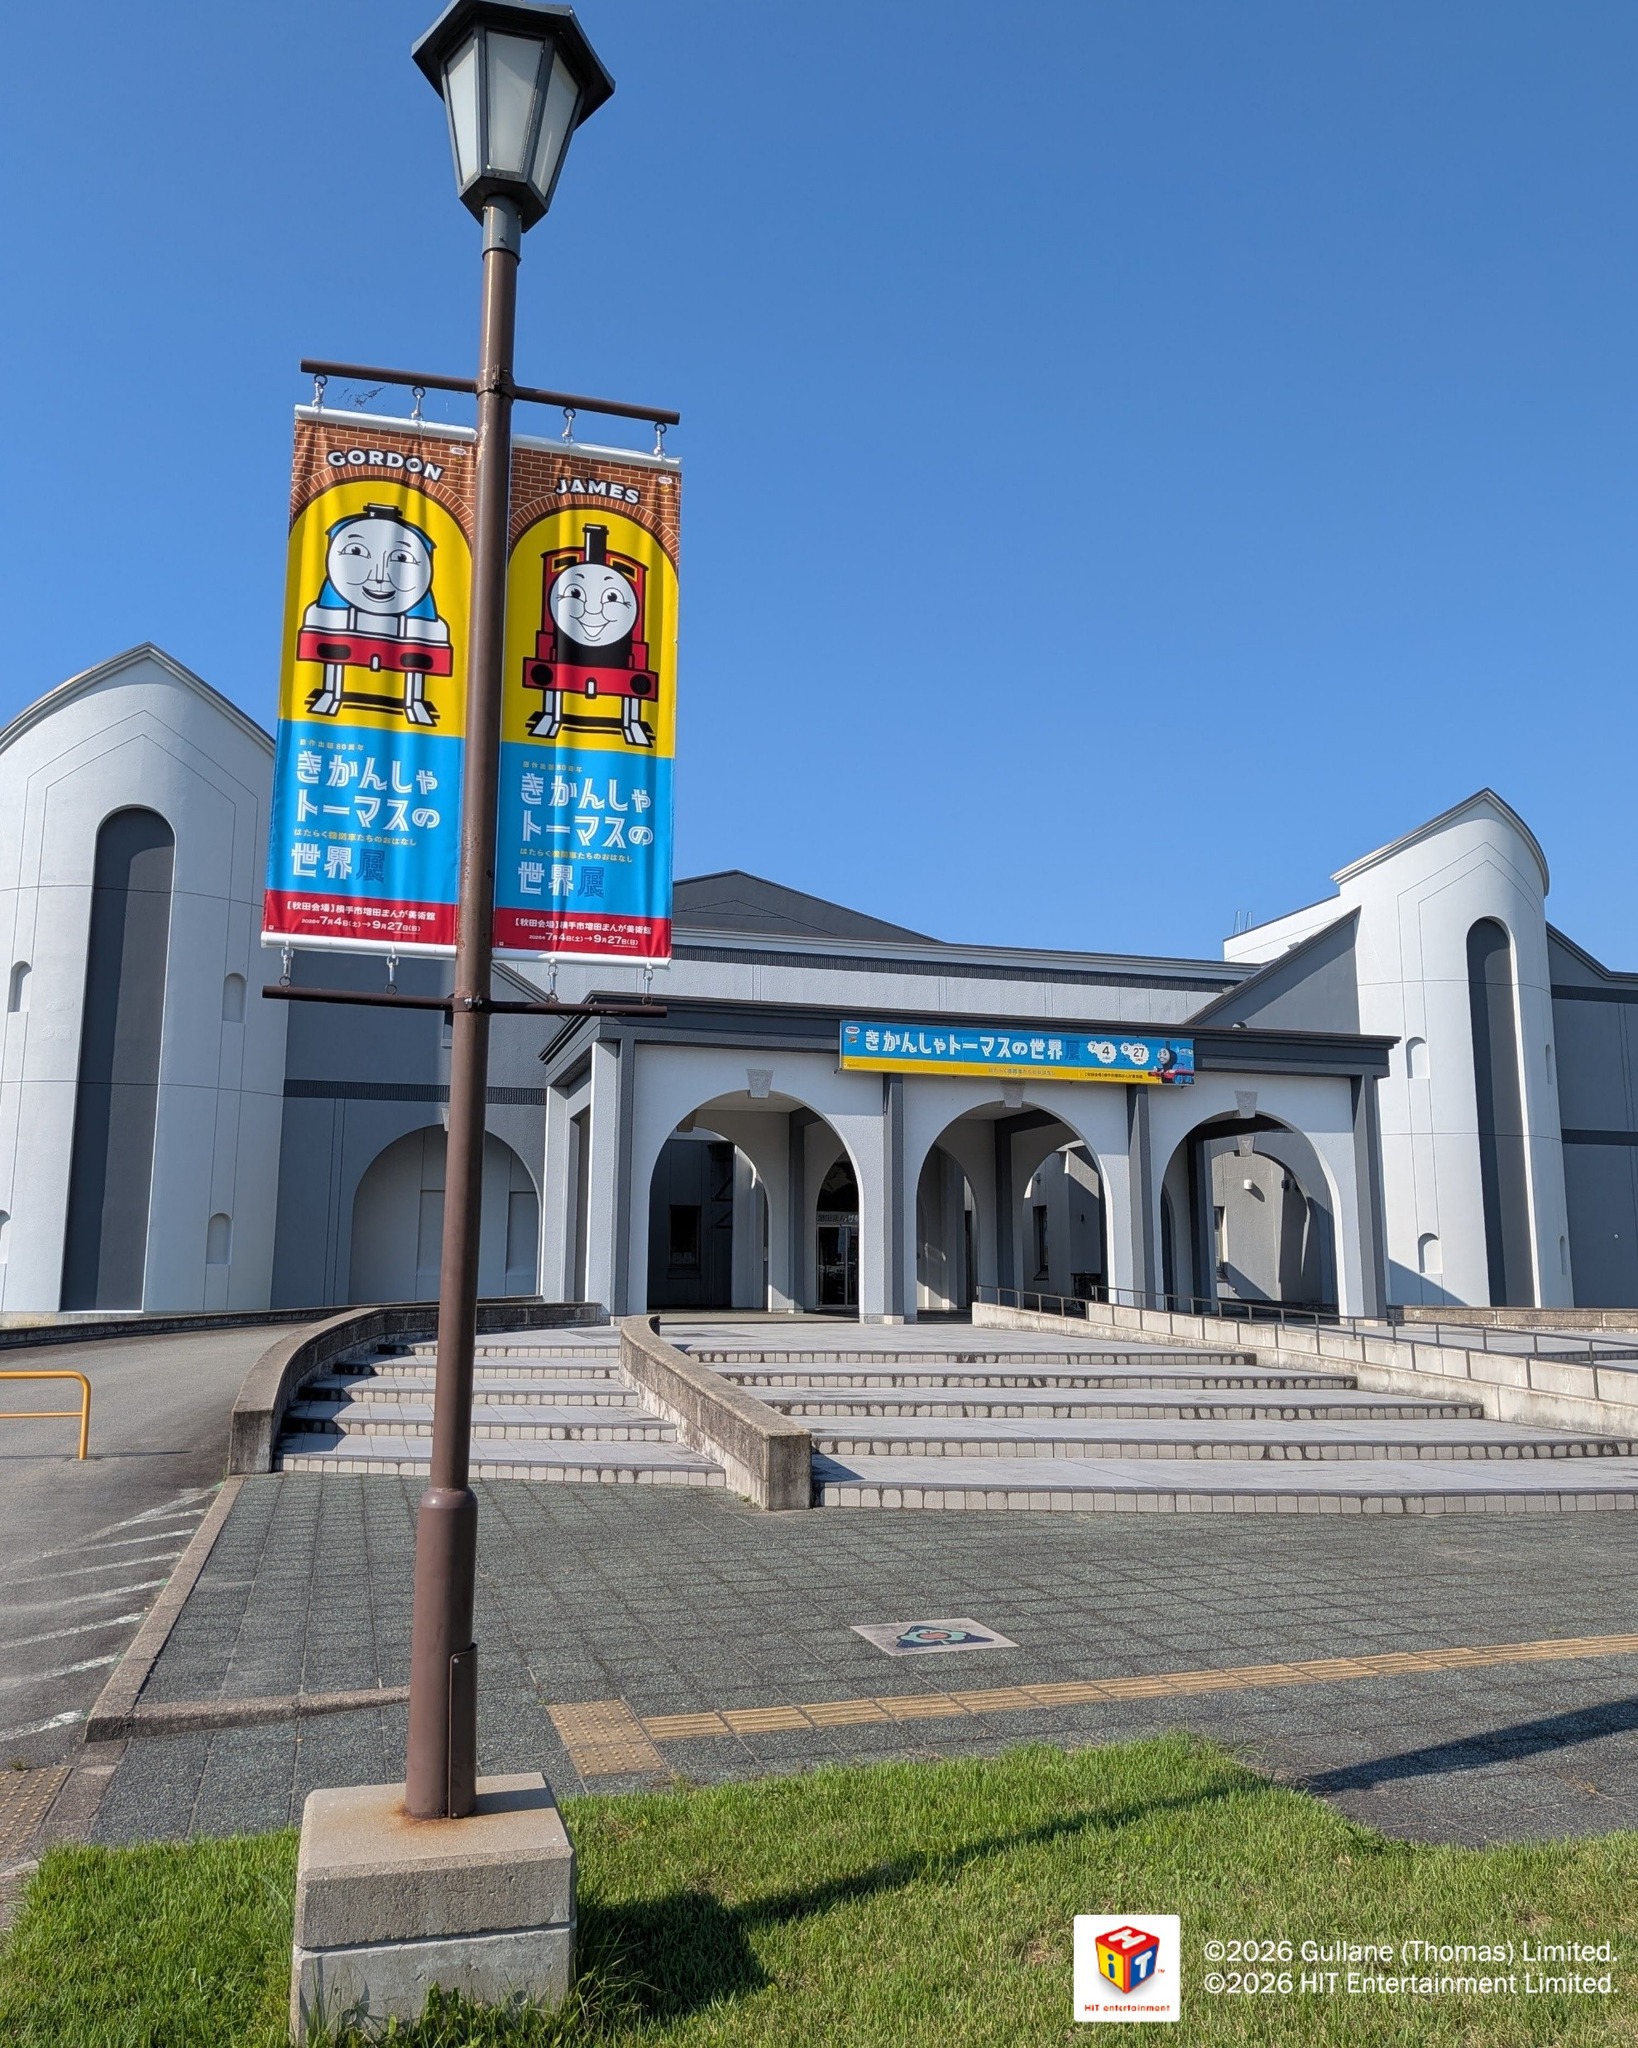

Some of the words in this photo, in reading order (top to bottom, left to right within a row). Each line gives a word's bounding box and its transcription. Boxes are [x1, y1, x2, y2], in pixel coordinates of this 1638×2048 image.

[327, 449, 444, 481] GORDON
[556, 477, 640, 505] JAMES
[296, 750, 438, 795] きかんしゃ
[296, 789, 441, 832] トーマスの
[521, 772, 651, 813] きかんしゃ
[521, 809, 654, 849] トーマスの
[291, 842, 386, 883] 世界展
[518, 861, 605, 898] 世界展
[865, 1030, 1080, 1060] きかんしゃトーマスの世界展
[1102, 1046, 1110, 1055] 4
[1133, 1047, 1145, 1058] 27
